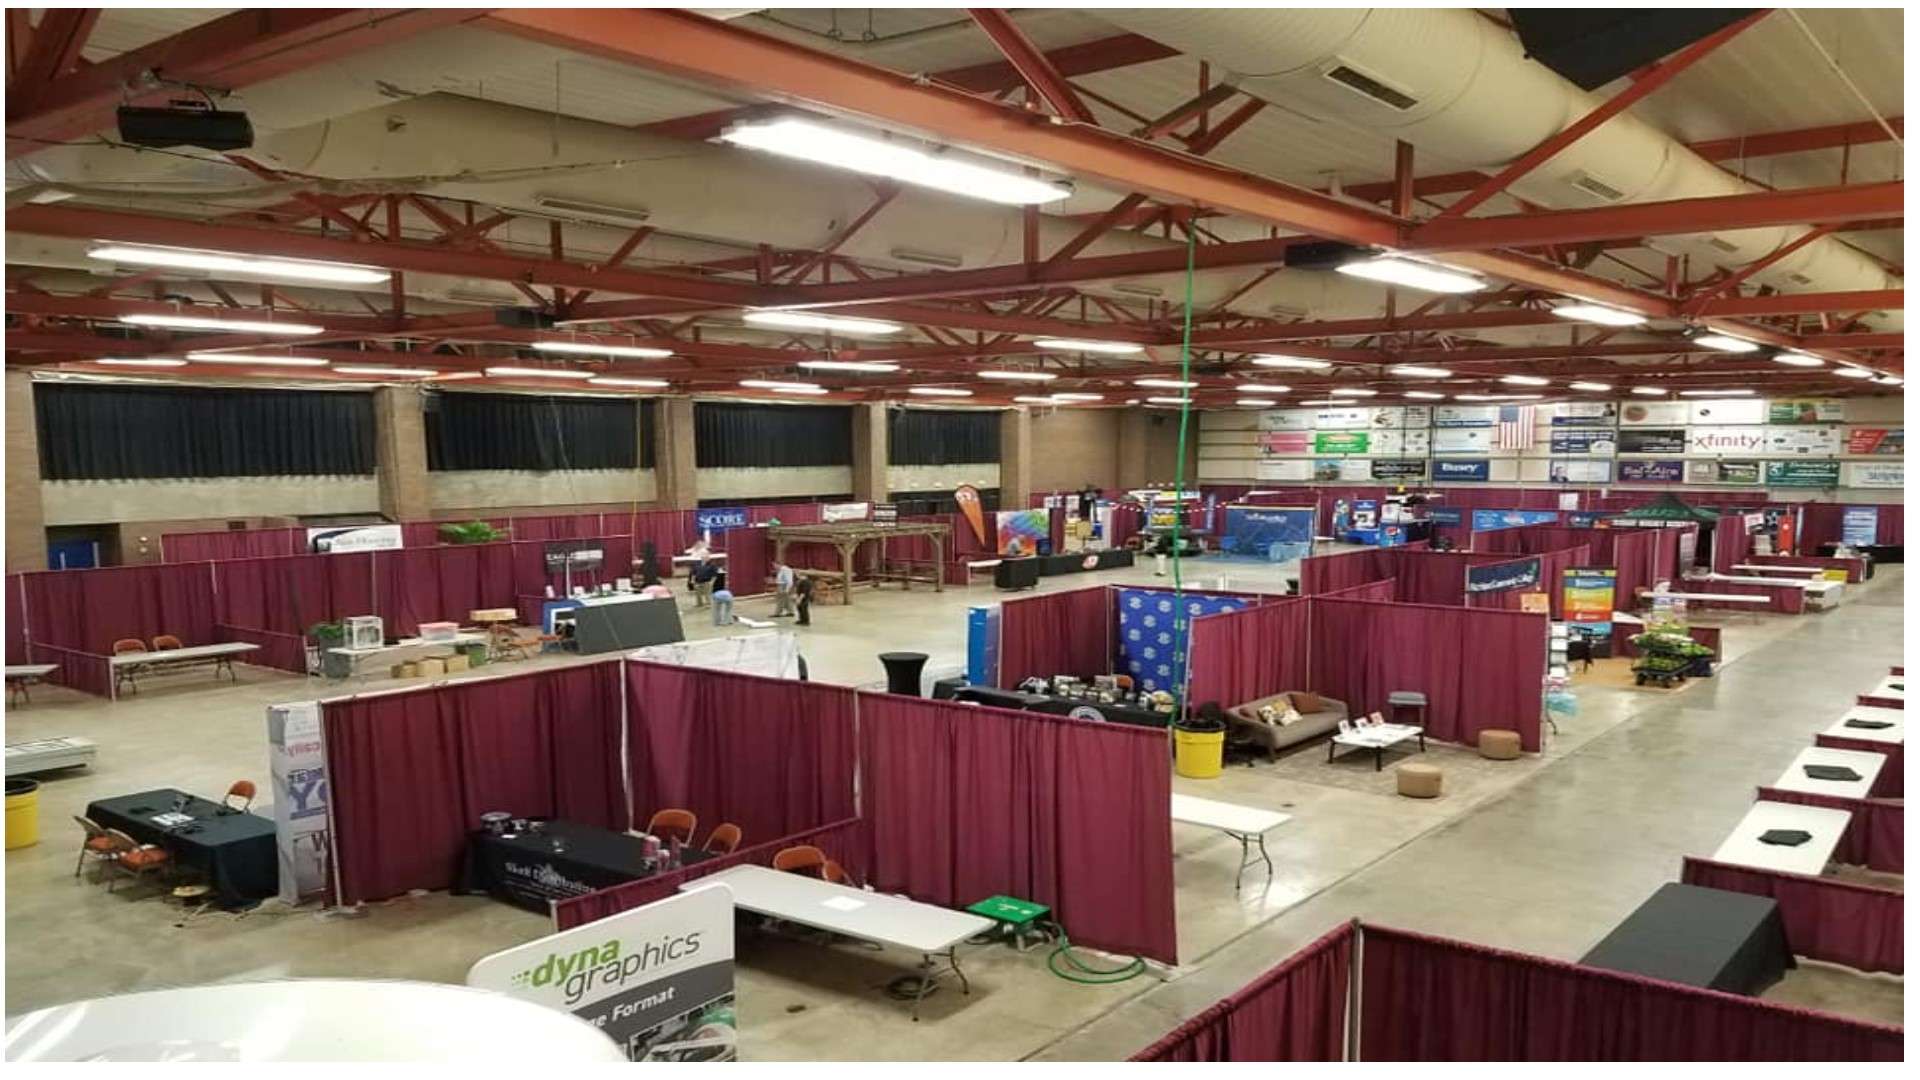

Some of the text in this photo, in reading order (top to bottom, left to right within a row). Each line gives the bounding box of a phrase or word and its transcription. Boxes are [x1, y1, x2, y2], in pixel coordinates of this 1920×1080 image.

[1694, 433, 1761, 449] xfinity
[532, 940, 621, 987] dyna
[565, 932, 702, 1005] graphics
[611, 986, 676, 1022] Format
